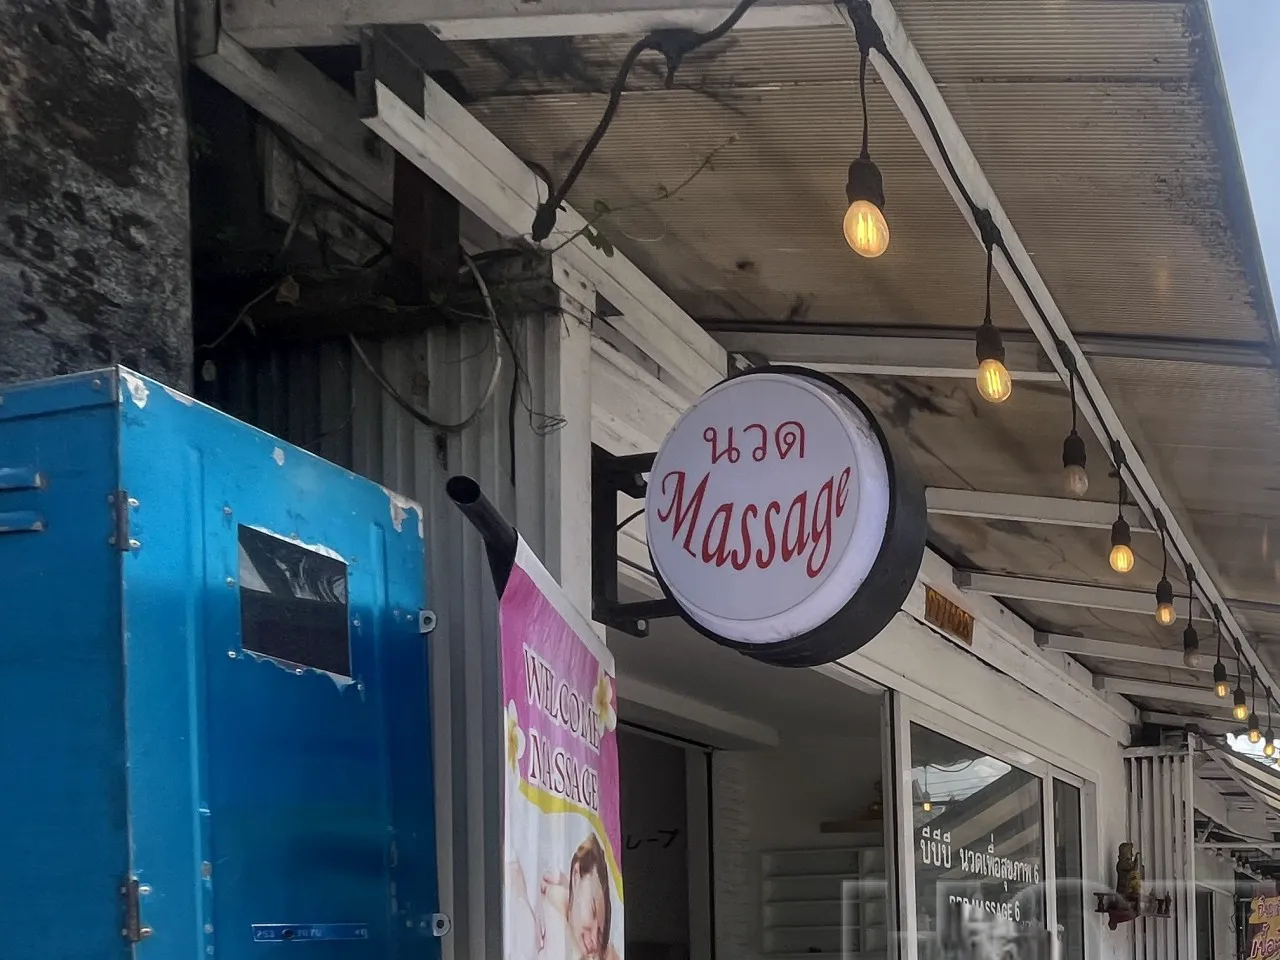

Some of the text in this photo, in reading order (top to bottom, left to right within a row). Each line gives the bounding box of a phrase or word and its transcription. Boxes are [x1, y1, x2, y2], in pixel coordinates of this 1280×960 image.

[703, 421, 805, 465] นวด
[657, 466, 851, 579] Massage
[525, 650, 600, 749] WELCOME
[1033, 864, 1039, 884] 6
[1014, 901, 1021, 921] 6
